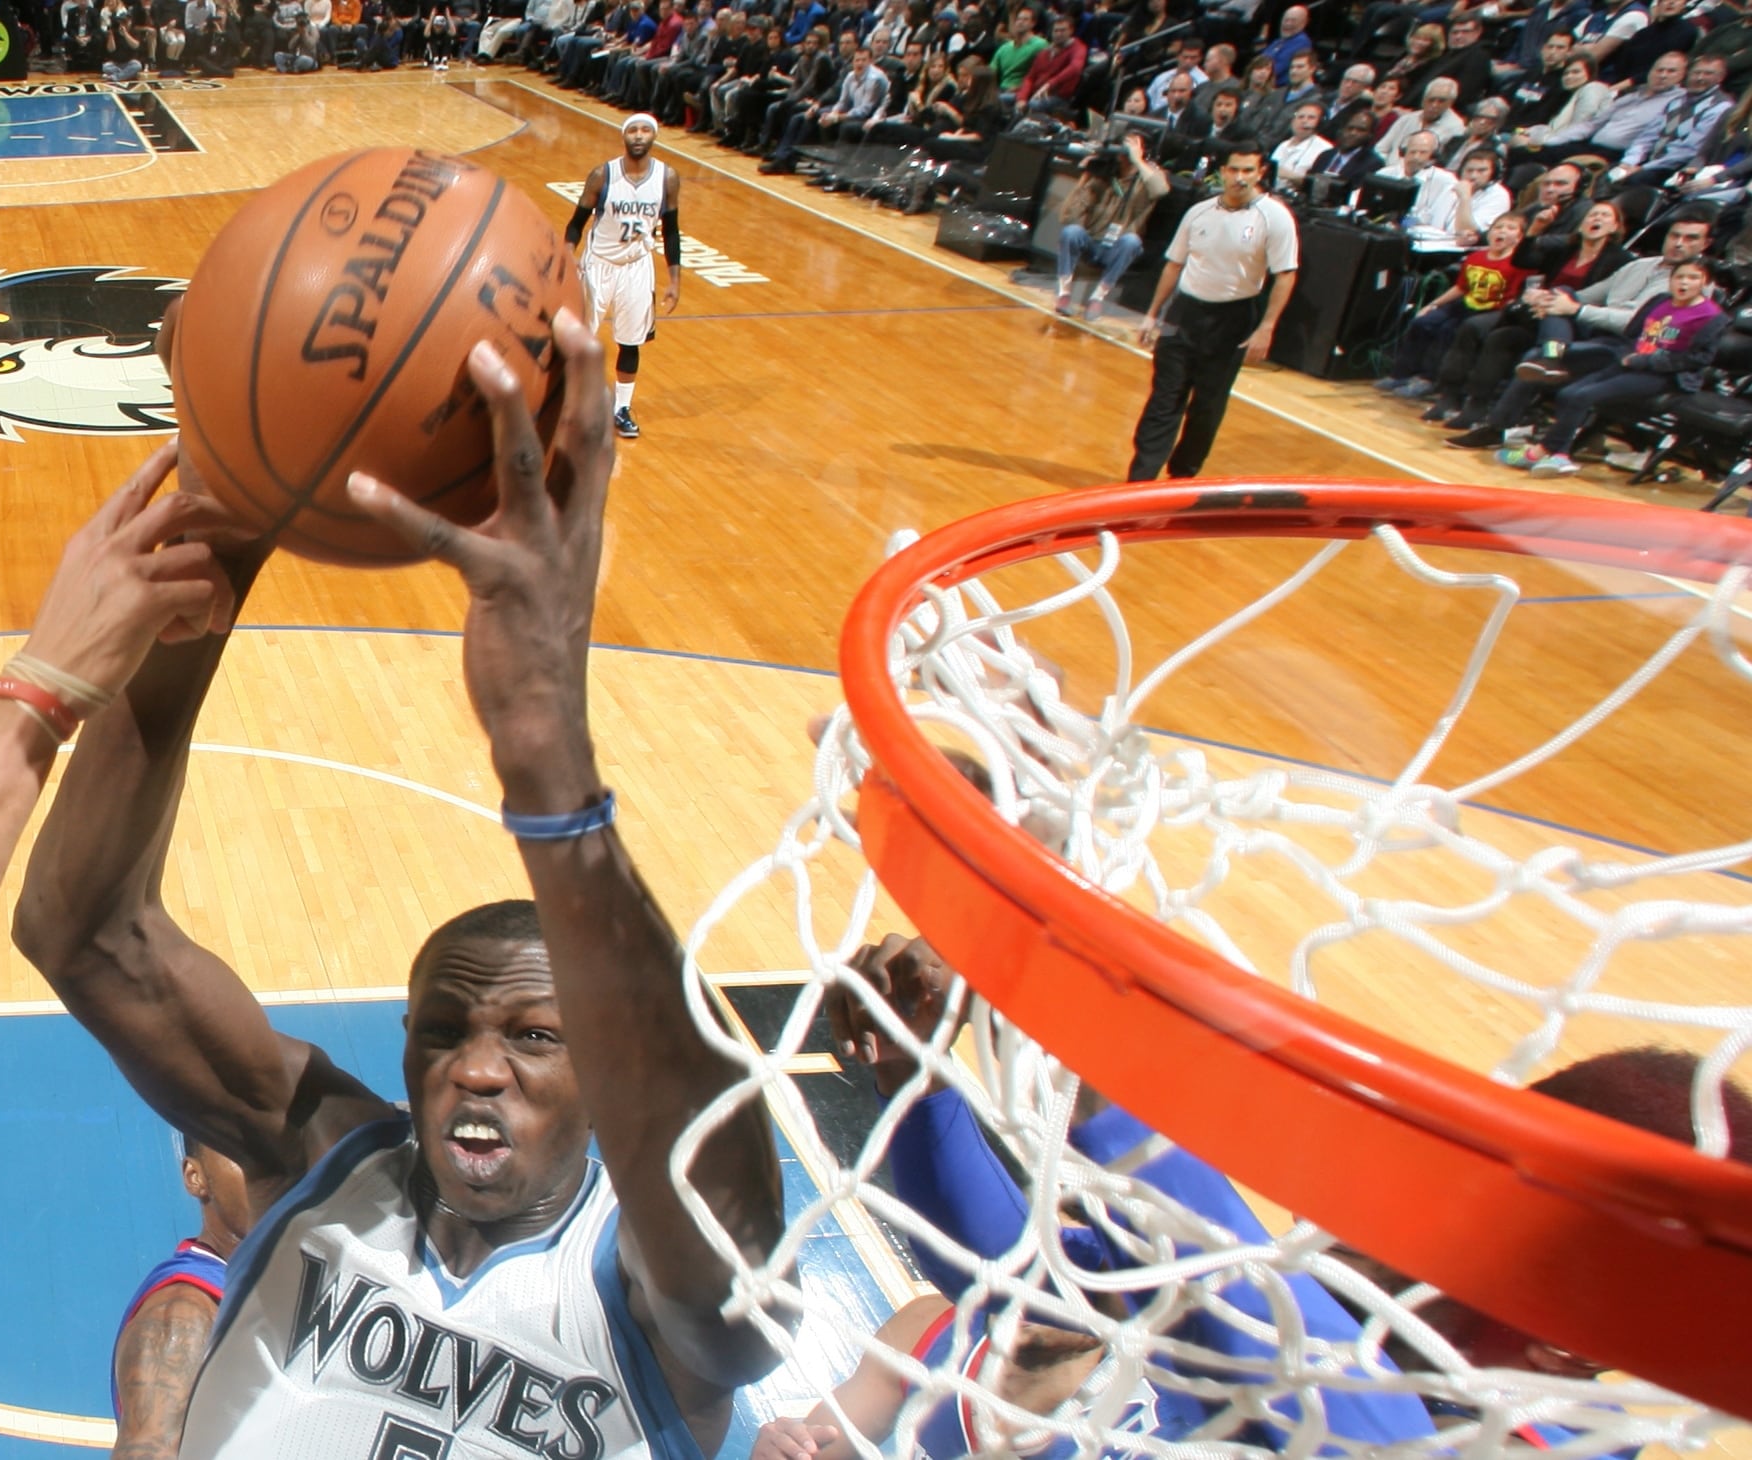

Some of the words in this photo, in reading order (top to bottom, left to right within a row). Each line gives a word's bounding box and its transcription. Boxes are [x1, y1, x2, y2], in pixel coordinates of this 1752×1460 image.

[611, 201, 657, 218] WOLVES
[619, 221, 644, 243] 25
[283, 1249, 619, 1460] WOLVES
